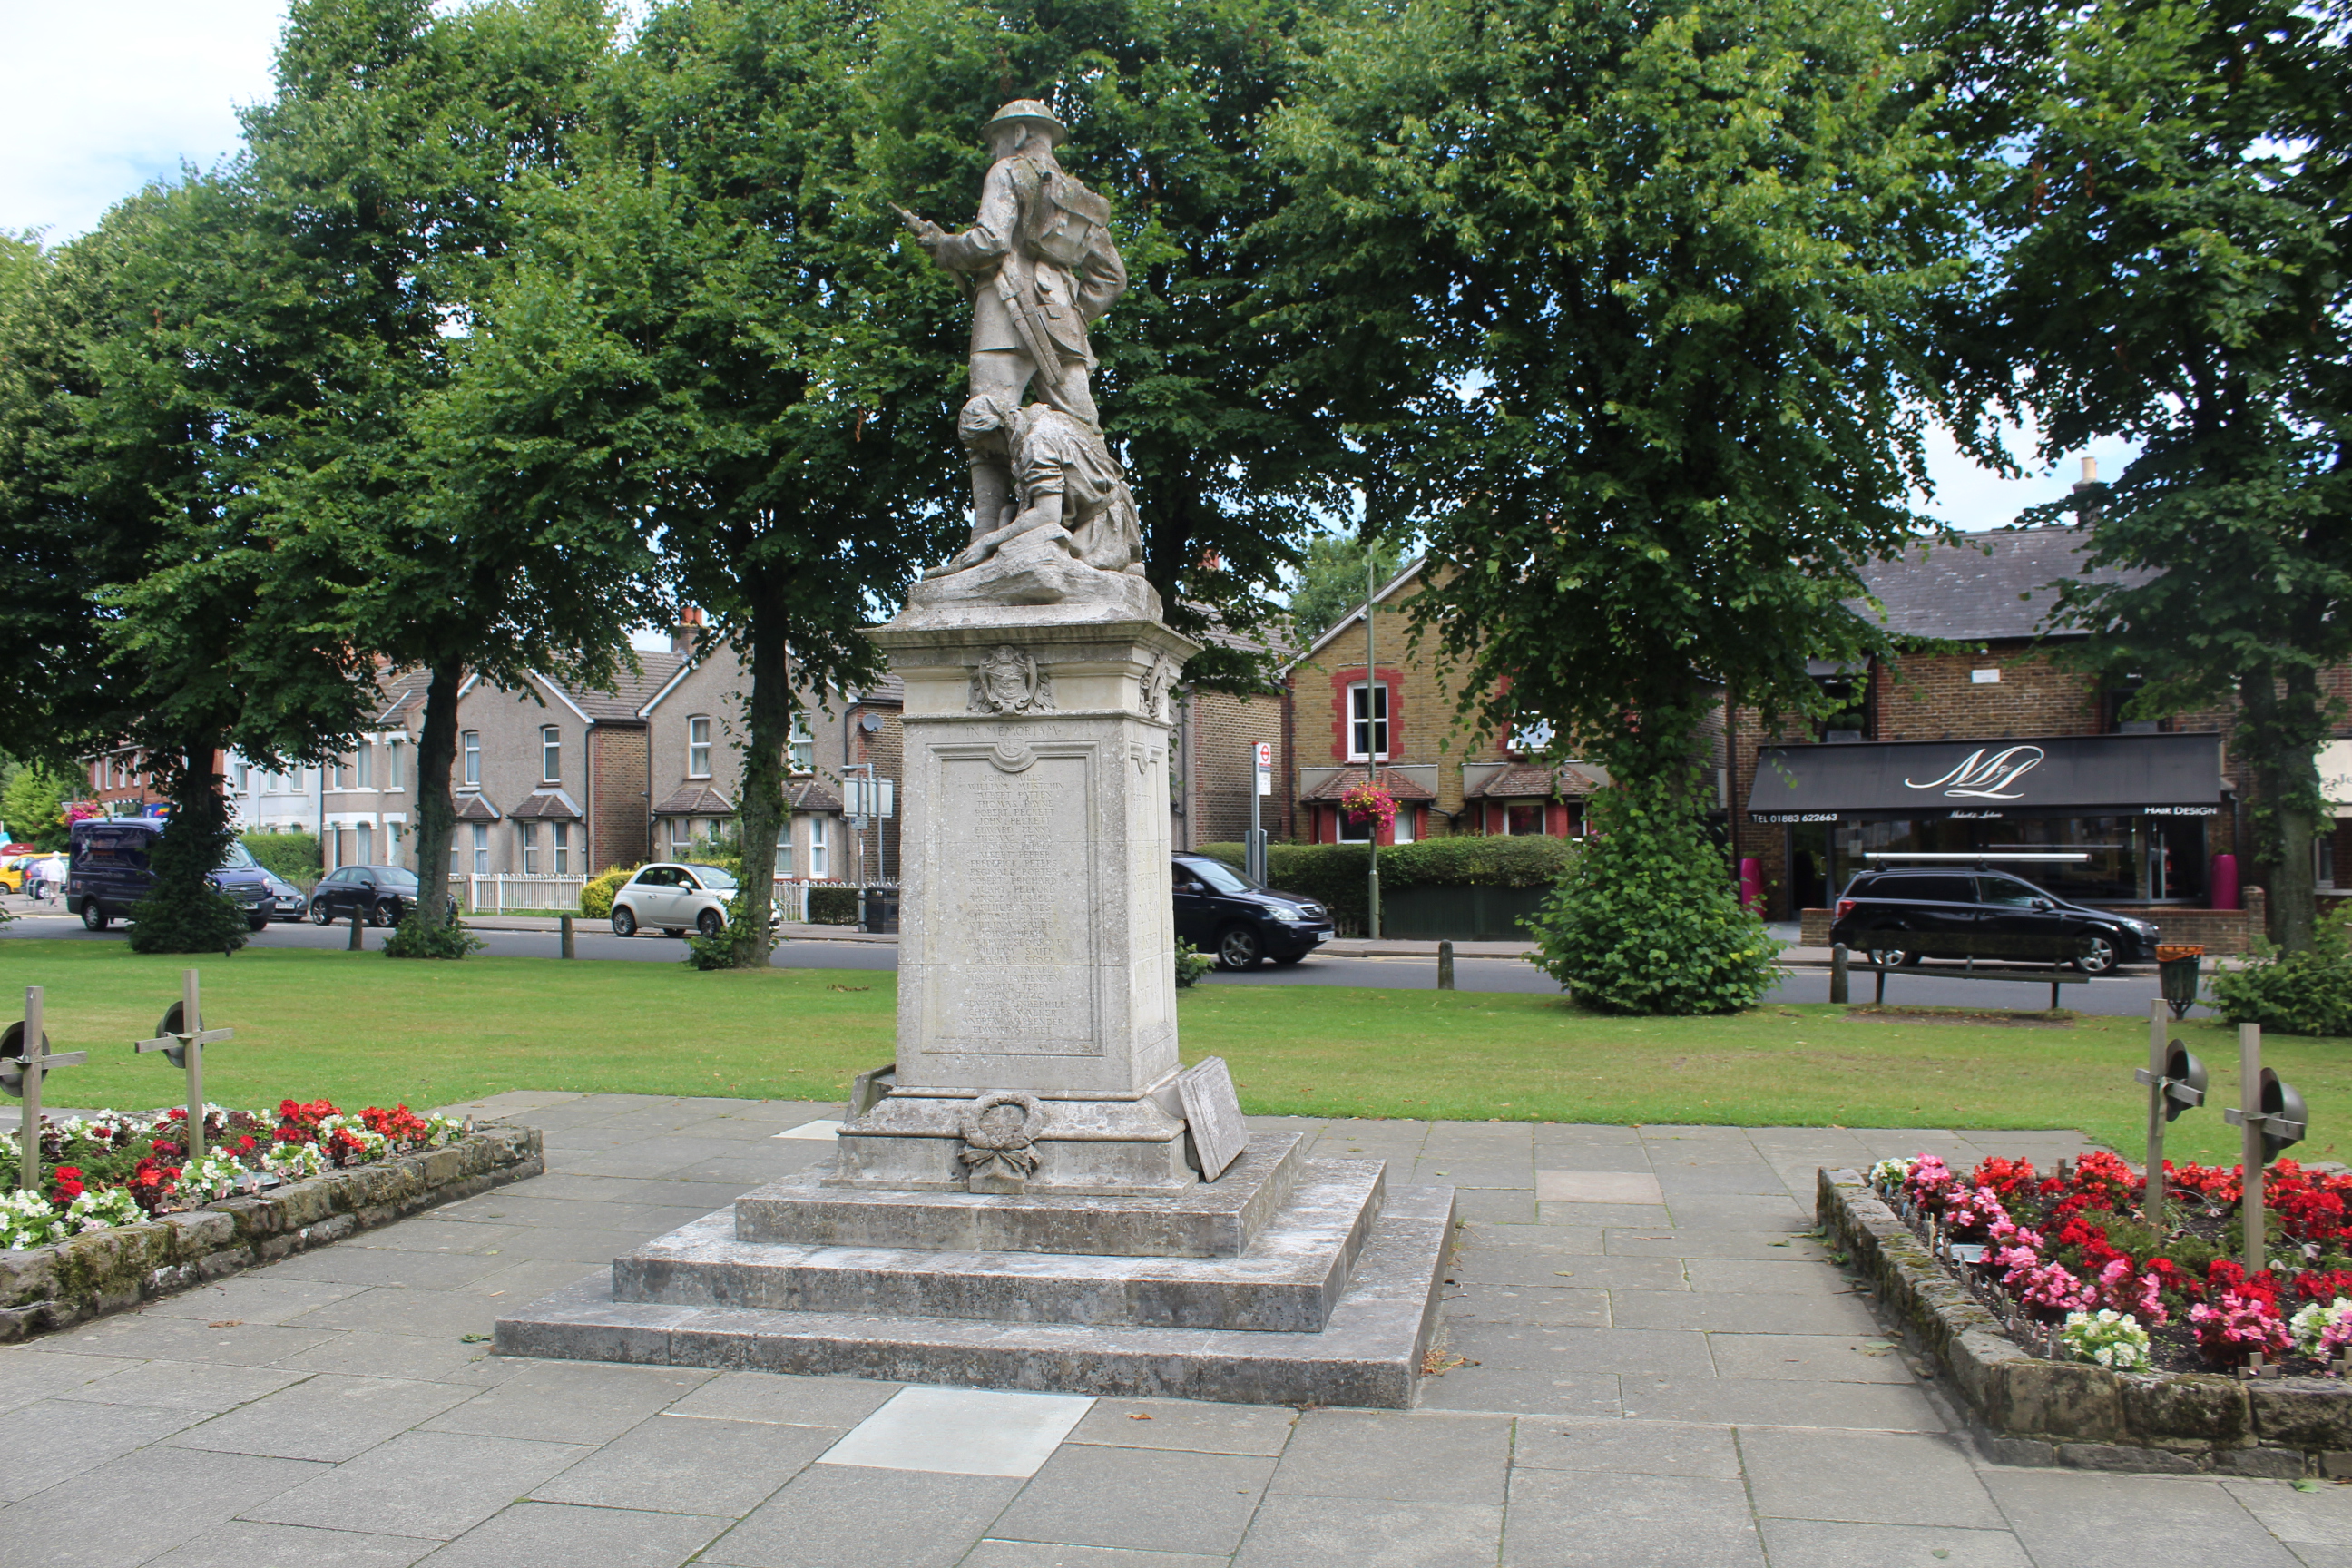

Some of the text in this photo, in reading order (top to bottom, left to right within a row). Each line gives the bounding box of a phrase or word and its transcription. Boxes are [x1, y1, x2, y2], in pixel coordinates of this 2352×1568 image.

[966, 727, 979, 736] IN
[1015, 774, 1043, 782] MILLS
[974, 791, 1011, 799] ALBERT
[975, 808, 1054, 817] ROBERT PECKETT
[2144, 806, 2218, 816] HAIR DESIGN
[1011, 818, 1051, 826] PECKETT
[1752, 813, 1838, 823] TEL 01883 622663
[975, 826, 1051, 834] EDWARD PENNY
[975, 834, 1015, 842] THOMAS
[1024, 859, 1057, 867] PETERS
[971, 886, 1005, 894] STUART
[969, 921, 1013, 929] WILLIAM
[972, 947, 1054, 956] WILLIAM SMITH
[975, 983, 1014, 991] EDWARD
[983, 991, 1007, 999] JOHN
[964, 1000, 1003, 1008] EDWARD
[973, 1026, 1052, 1034] EDWARD STREET
